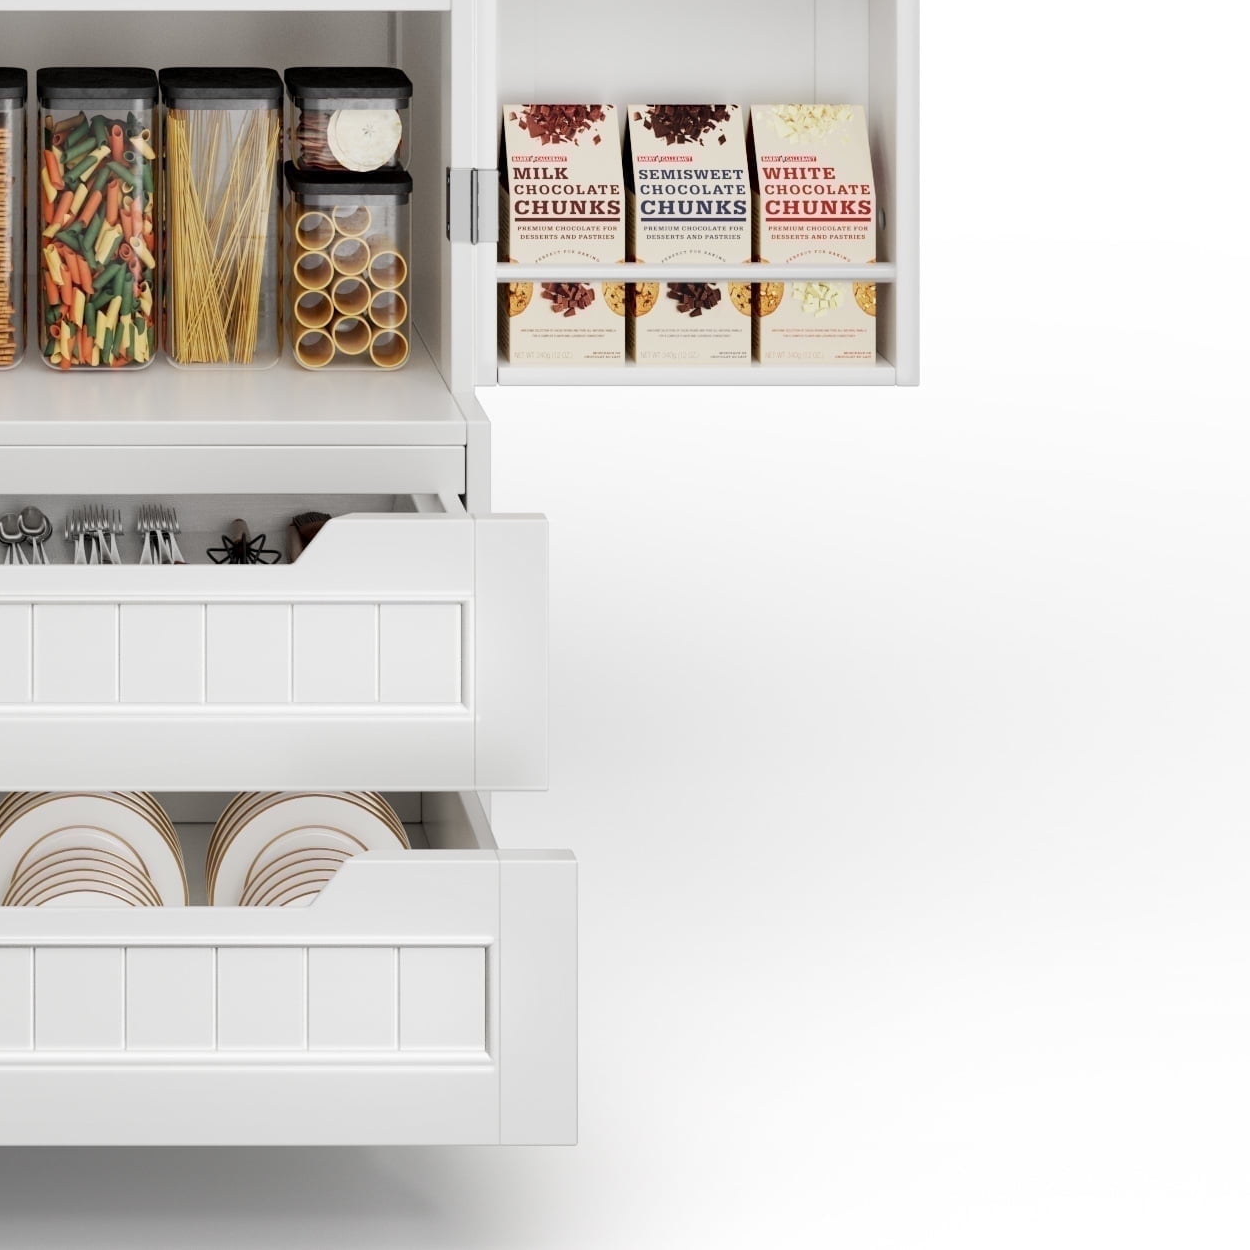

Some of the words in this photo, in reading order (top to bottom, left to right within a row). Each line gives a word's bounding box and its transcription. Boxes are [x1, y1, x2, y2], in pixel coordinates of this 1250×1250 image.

[513, 167, 568, 180] MILK
[638, 169, 743, 180] SEMISWEET
[762, 167, 836, 180] WHITE
[514, 184, 620, 195] CHOCOLATE
[640, 184, 746, 195] CHOCOLATE
[764, 184, 871, 195] CHOCOLATE
[515, 200, 621, 215] CHUNKS
[640, 200, 747, 215] CHUNKS
[765, 200, 871, 215] CHUNKS
